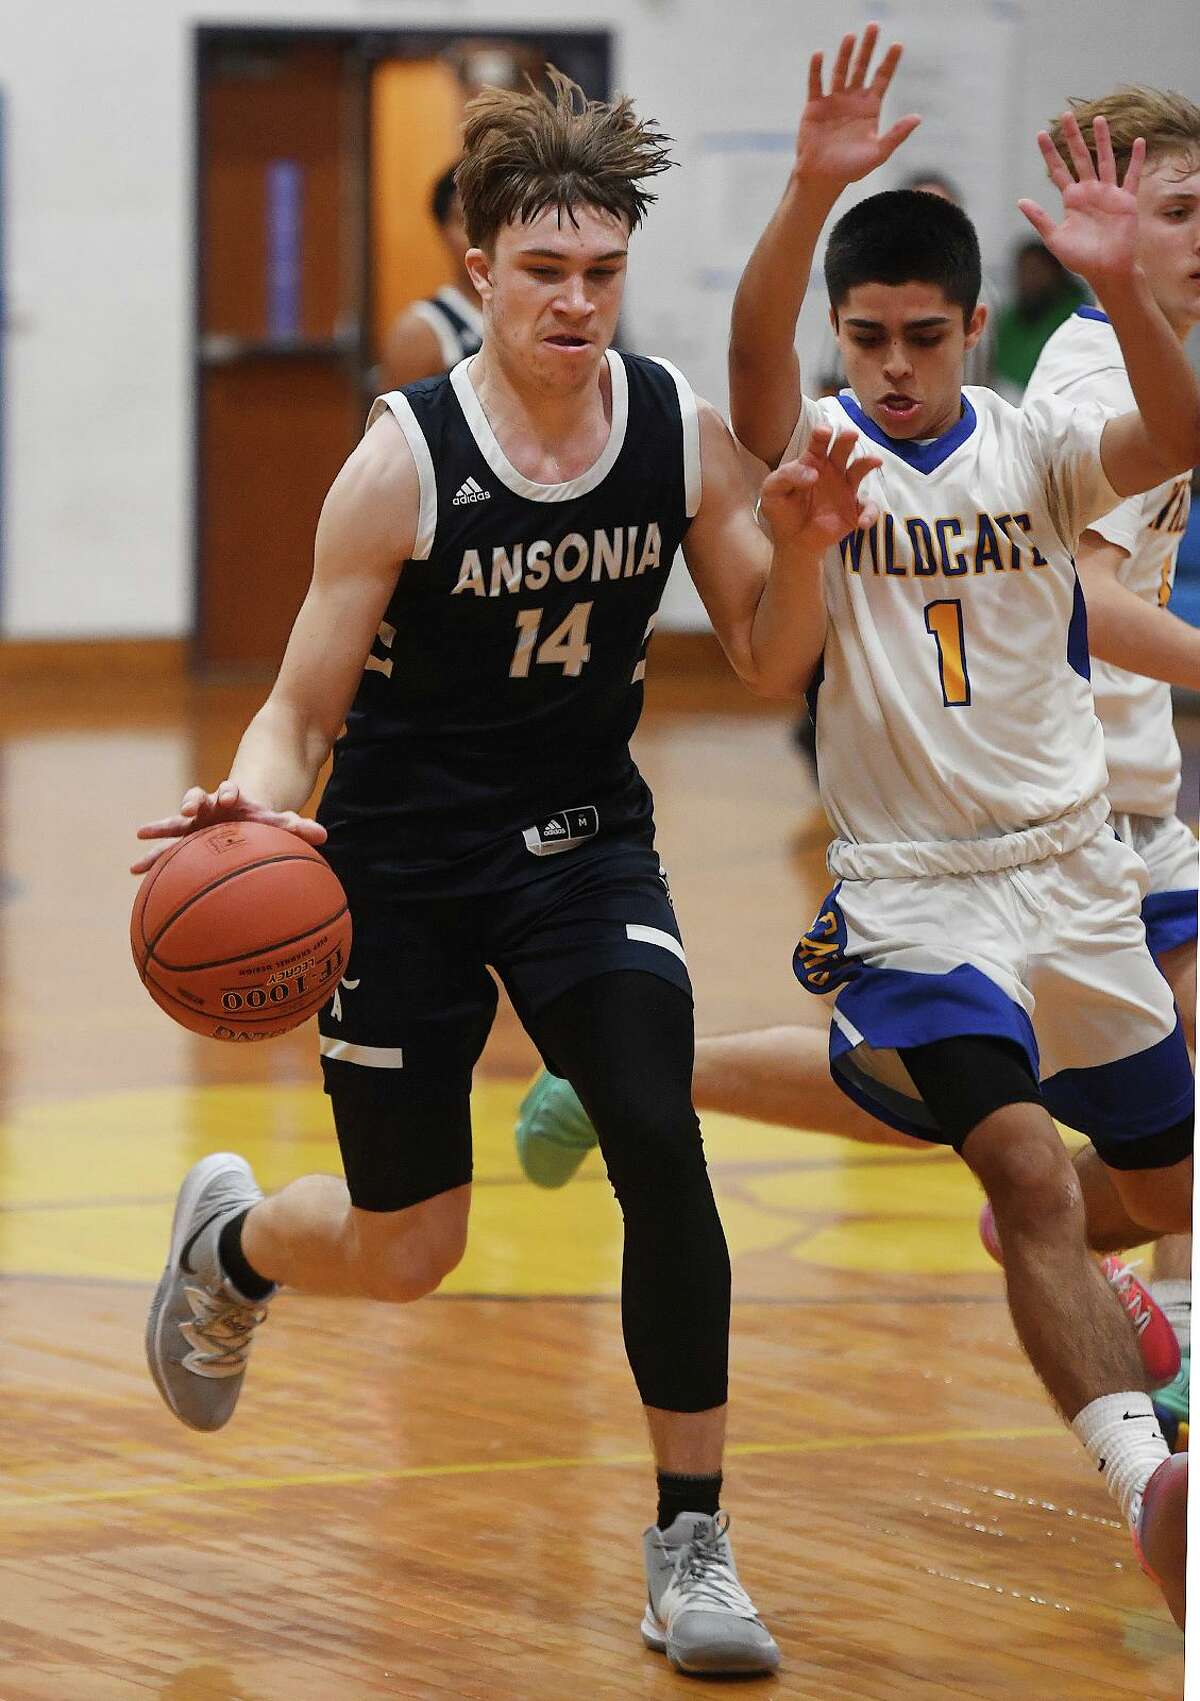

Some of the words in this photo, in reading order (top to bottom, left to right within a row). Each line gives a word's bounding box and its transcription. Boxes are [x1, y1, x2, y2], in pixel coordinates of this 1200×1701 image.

[452, 489, 491, 506] adidas
[450, 521, 662, 597] ANSONIA
[508, 600, 594, 678] 14
[923, 599, 971, 707] 1
[578, 817, 588, 827] M
[266, 957, 316, 986] LEGACY
